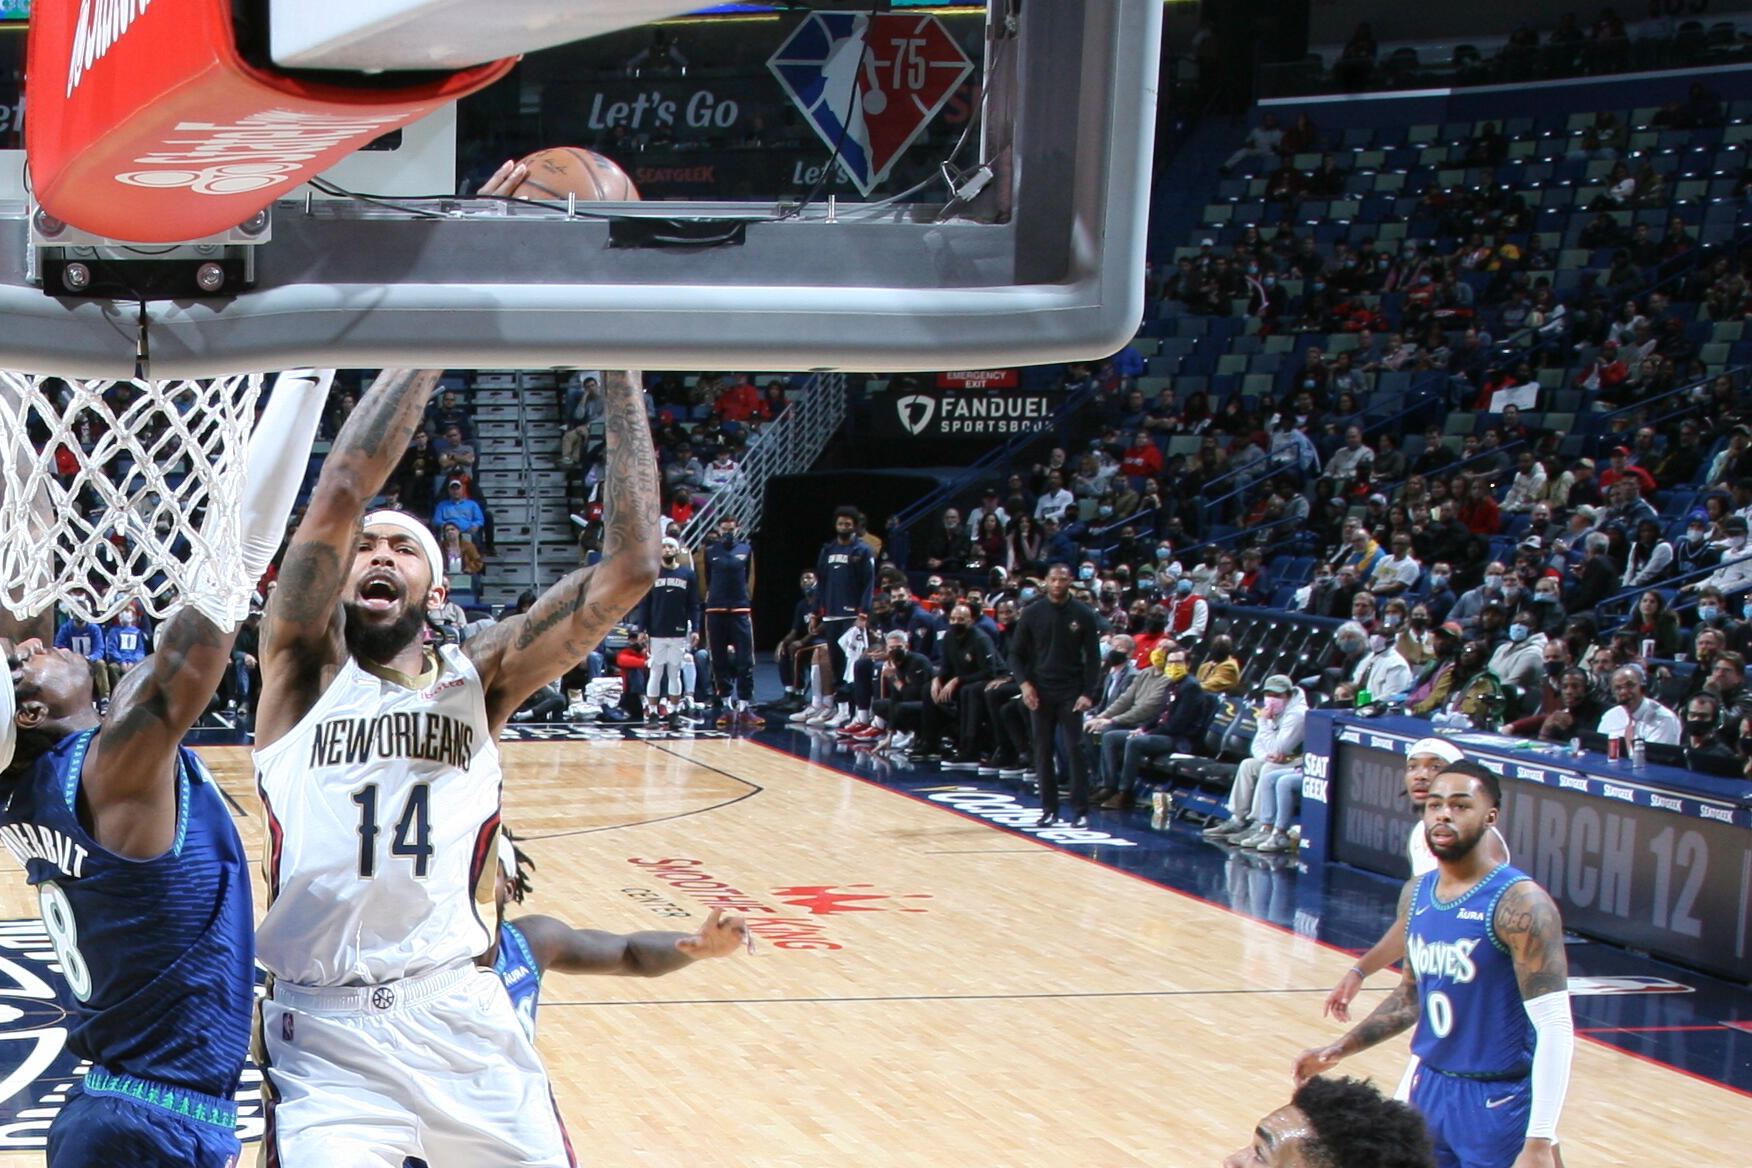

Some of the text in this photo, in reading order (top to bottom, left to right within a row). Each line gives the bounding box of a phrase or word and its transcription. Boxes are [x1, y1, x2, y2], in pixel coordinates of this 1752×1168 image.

[890, 37, 927, 90] 75
[686, 90, 739, 129] Go
[946, 371, 1008, 380] EMERGENCY
[965, 380, 988, 389] EXIT
[941, 397, 1055, 418] FANDUEL
[309, 712, 474, 774] NEW ORLEANS
[1303, 752, 1329, 778] SEAT
[1302, 776, 1328, 804] GEEK
[350, 779, 435, 881] 14
[1649, 825, 1709, 939] 12
[38, 880, 94, 1003] 8
[1426, 989, 1454, 1039] 0
